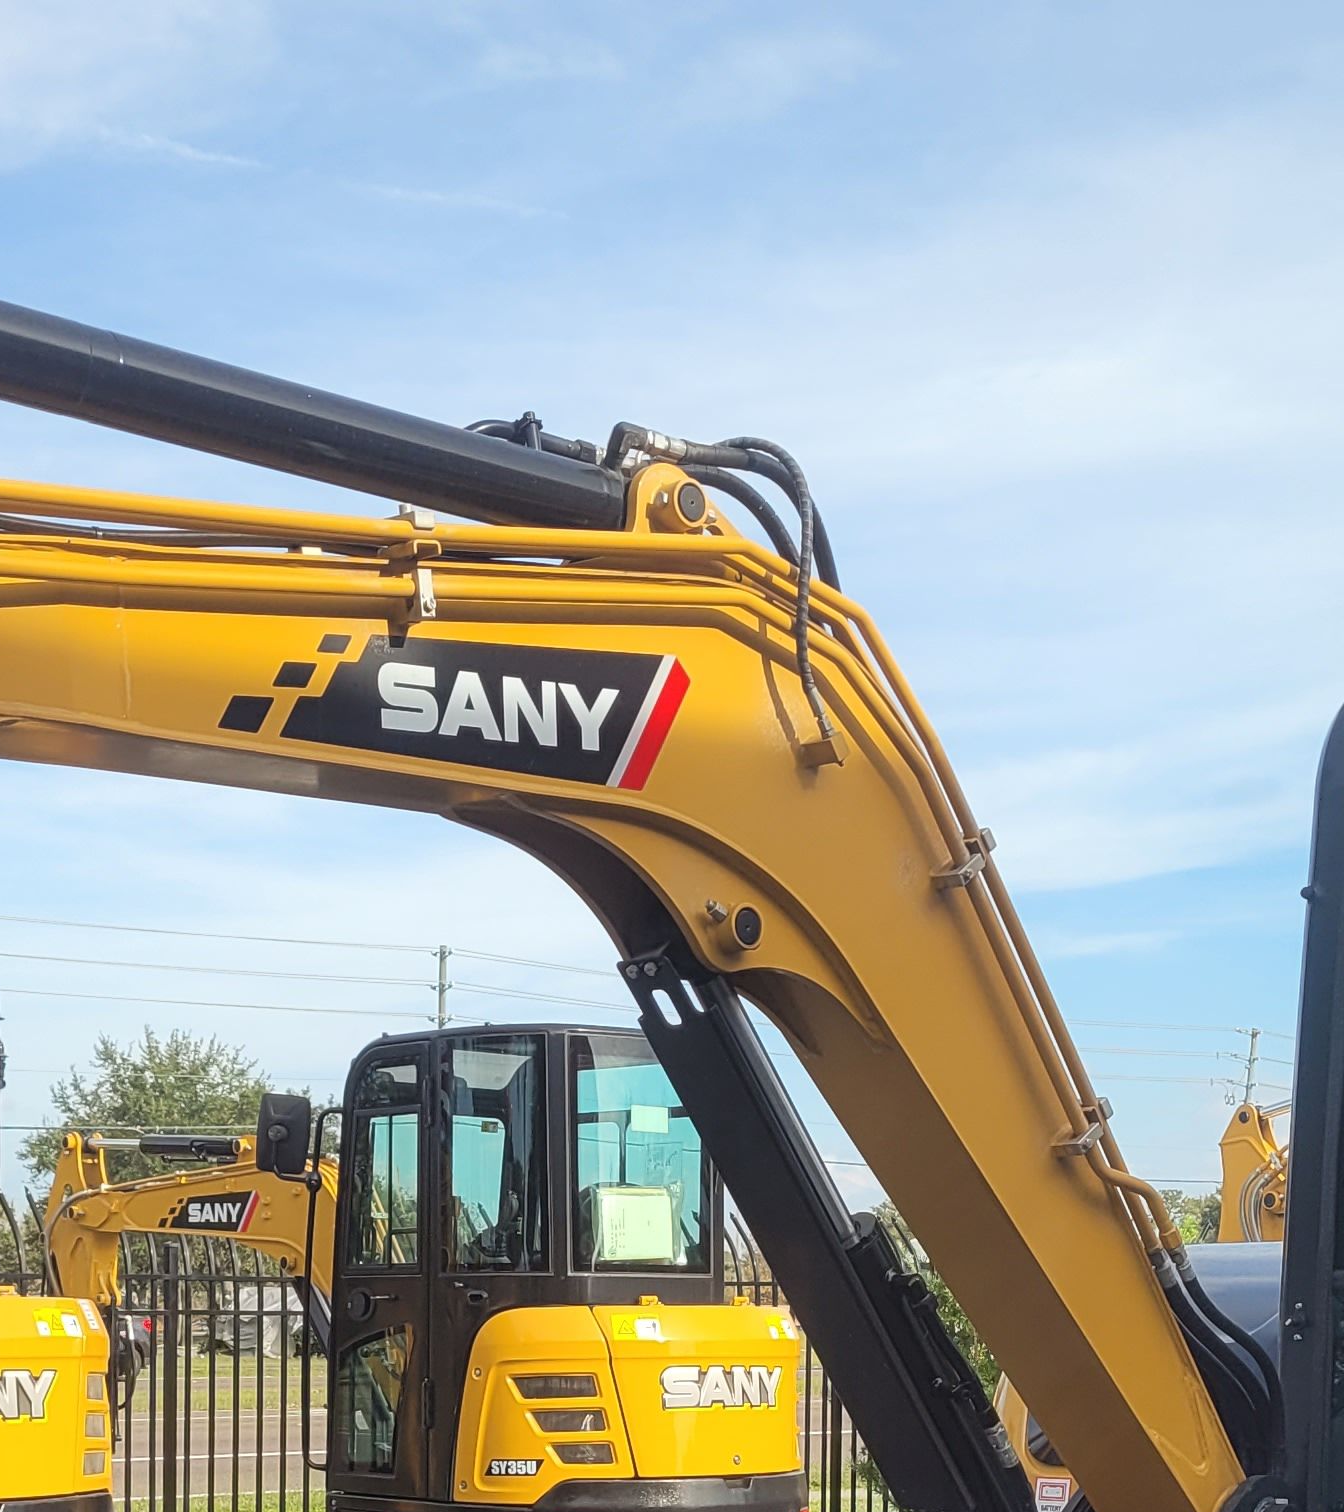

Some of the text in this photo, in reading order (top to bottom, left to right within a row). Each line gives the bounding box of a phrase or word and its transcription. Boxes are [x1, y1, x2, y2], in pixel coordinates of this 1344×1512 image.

[377, 661, 620, 751] SANY
[187, 1203, 242, 1223] SANY
[660, 1365, 782, 1410] SANY
[490, 1460, 537, 1475] SY35U
